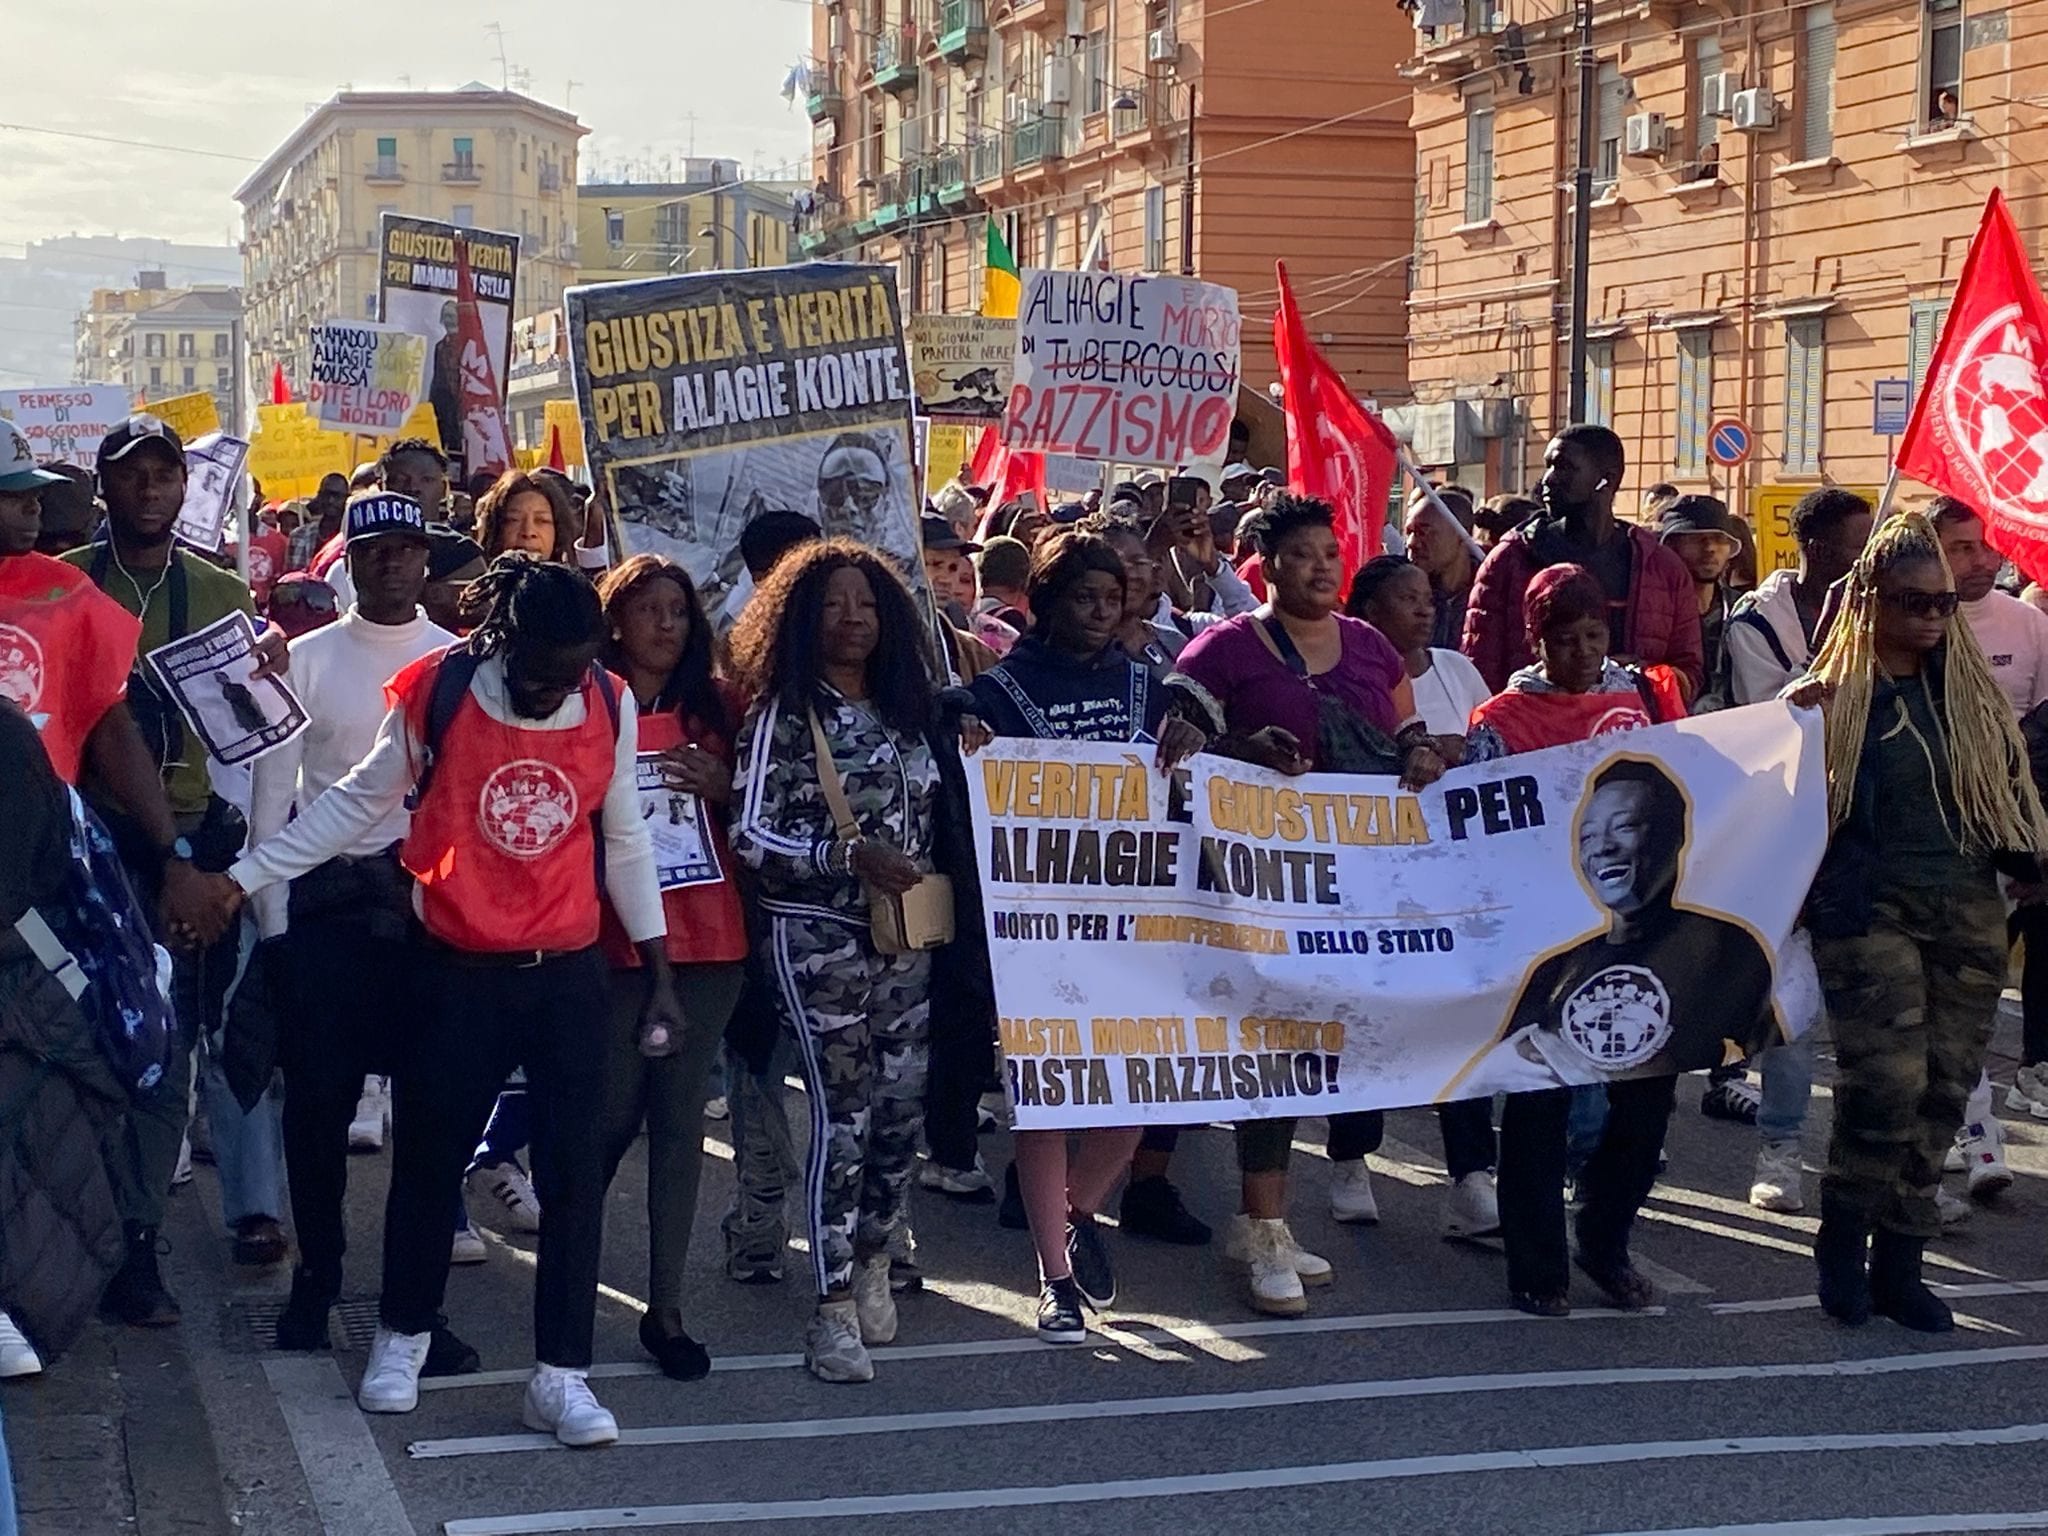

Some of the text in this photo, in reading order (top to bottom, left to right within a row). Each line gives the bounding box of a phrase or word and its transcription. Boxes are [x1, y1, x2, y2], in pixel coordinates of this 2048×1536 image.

[389, 229, 512, 273] GIUSTIZA VERITÀ
[387, 260, 410, 283] PER
[479, 274, 511, 299] SYLLA
[1026, 275, 1148, 331] ALHAGIE
[311, 327, 378, 350] MAMADOU
[585, 275, 896, 378] GIUSTIZA E VERITÀ
[1161, 302, 1238, 350] MORTO
[314, 344, 372, 368] ALHAGIE
[921, 345, 971, 361] PANTERE
[1022, 336, 1238, 394] DI TUBERCOLOSI
[311, 362, 368, 387] MOUSSA
[19, 393, 93, 408] PERMESSO
[55, 408, 70, 421] DI
[310, 383, 410, 413] DITE I LORO
[592, 380, 666, 443] PER
[672, 360, 791, 432] ALAGIE
[794, 347, 906, 413] KONTE
[25, 424, 109, 439] SOGGIORNO
[340, 408, 386, 426] NOMI
[50, 437, 77, 452] PER
[353, 501, 422, 529] NARCOS
[983, 753, 1546, 846] VERITÀ E GIUSTIZIA PER
[991, 826, 1341, 905] ALHAGIE KONTE
[1067, 914, 1107, 941] PER
[1297, 930, 1369, 955] DELLO
[1378, 927, 1454, 955] STATO
[1091, 1017, 1188, 1055] MORTI
[1239, 1016, 1345, 1053] STATO
[1125, 1053, 1341, 1104] RAZZISMO!
